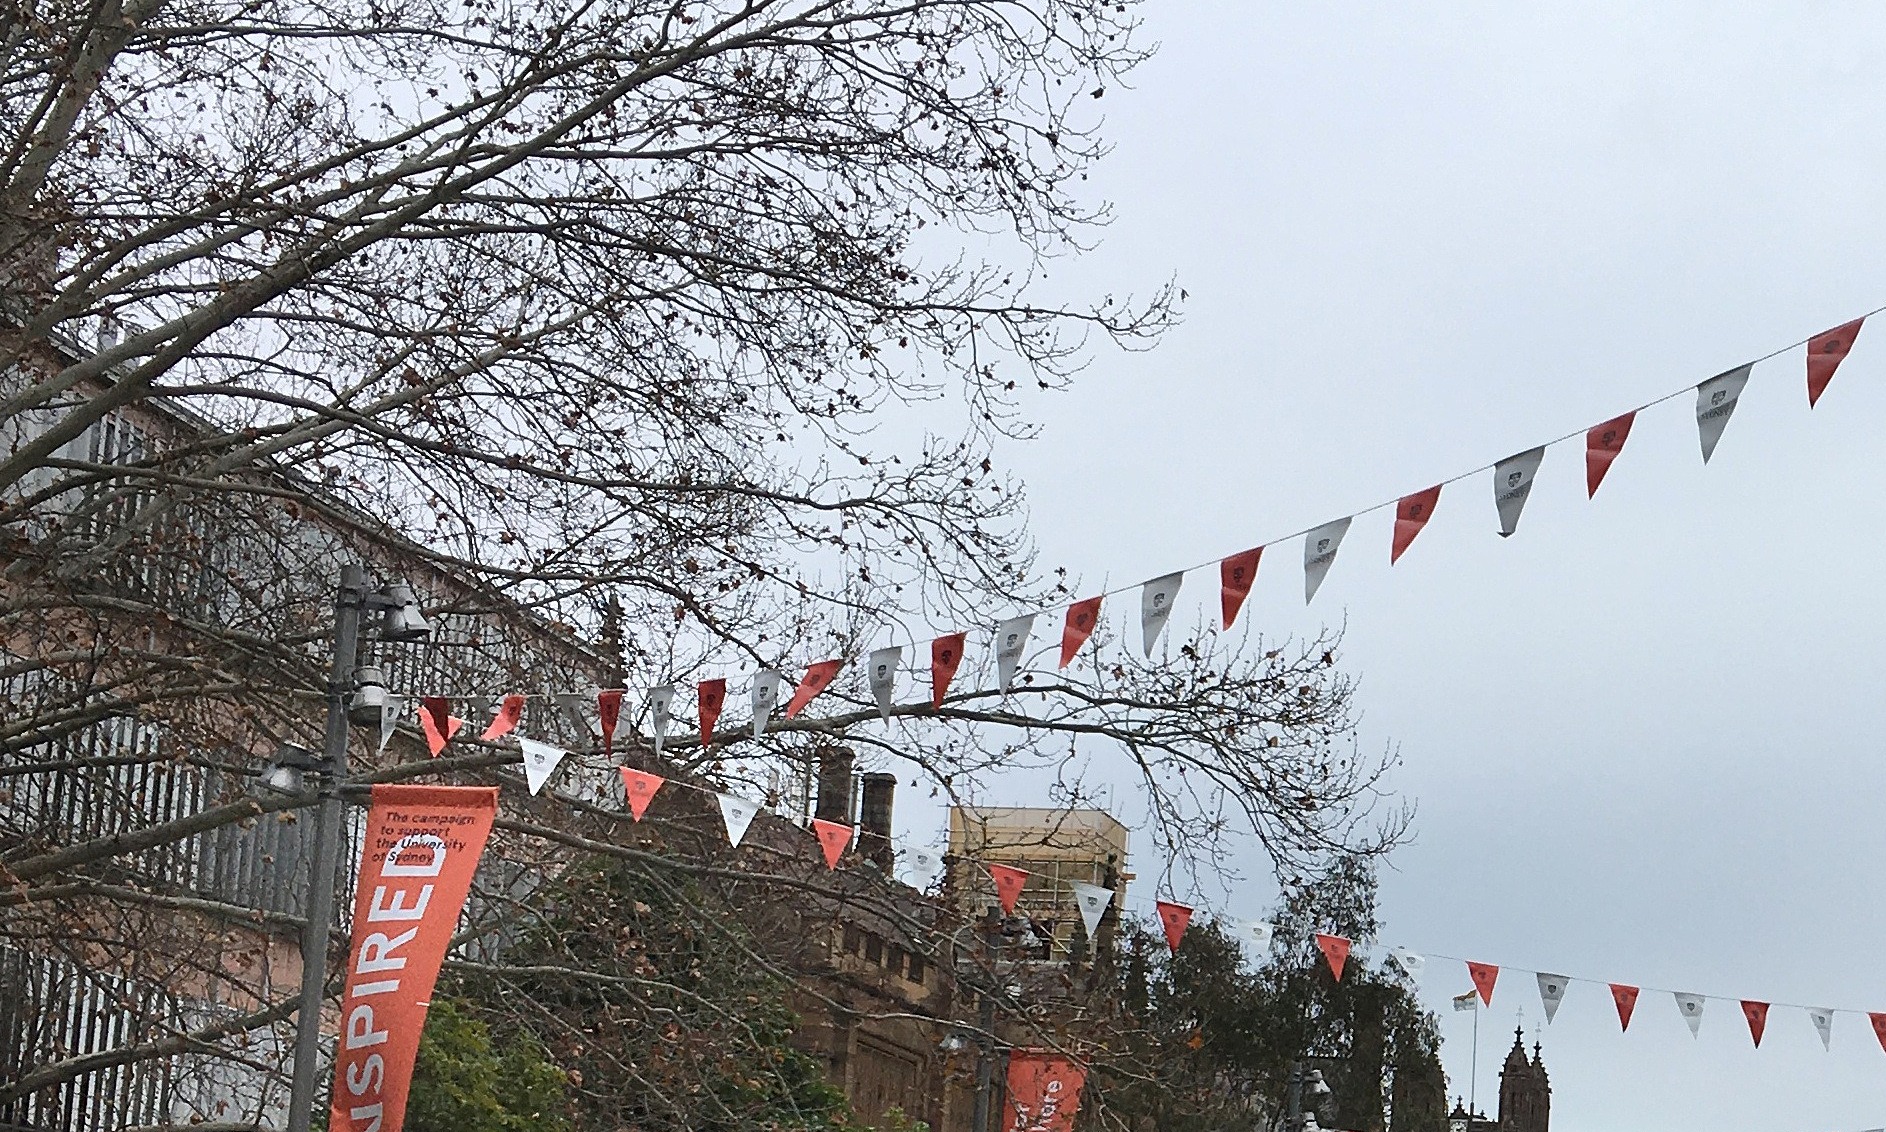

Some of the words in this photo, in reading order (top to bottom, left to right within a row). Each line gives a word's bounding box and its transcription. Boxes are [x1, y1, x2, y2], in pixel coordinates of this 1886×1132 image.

[386, 811, 408, 823] The
[411, 814, 476, 826] campaign
[381, 826, 394, 835] to
[397, 827, 450, 838] support
[376, 838, 397, 849] the
[401, 839, 467, 852] University
[371, 852, 386, 862] of
[1029, 1080, 1063, 1132] here
